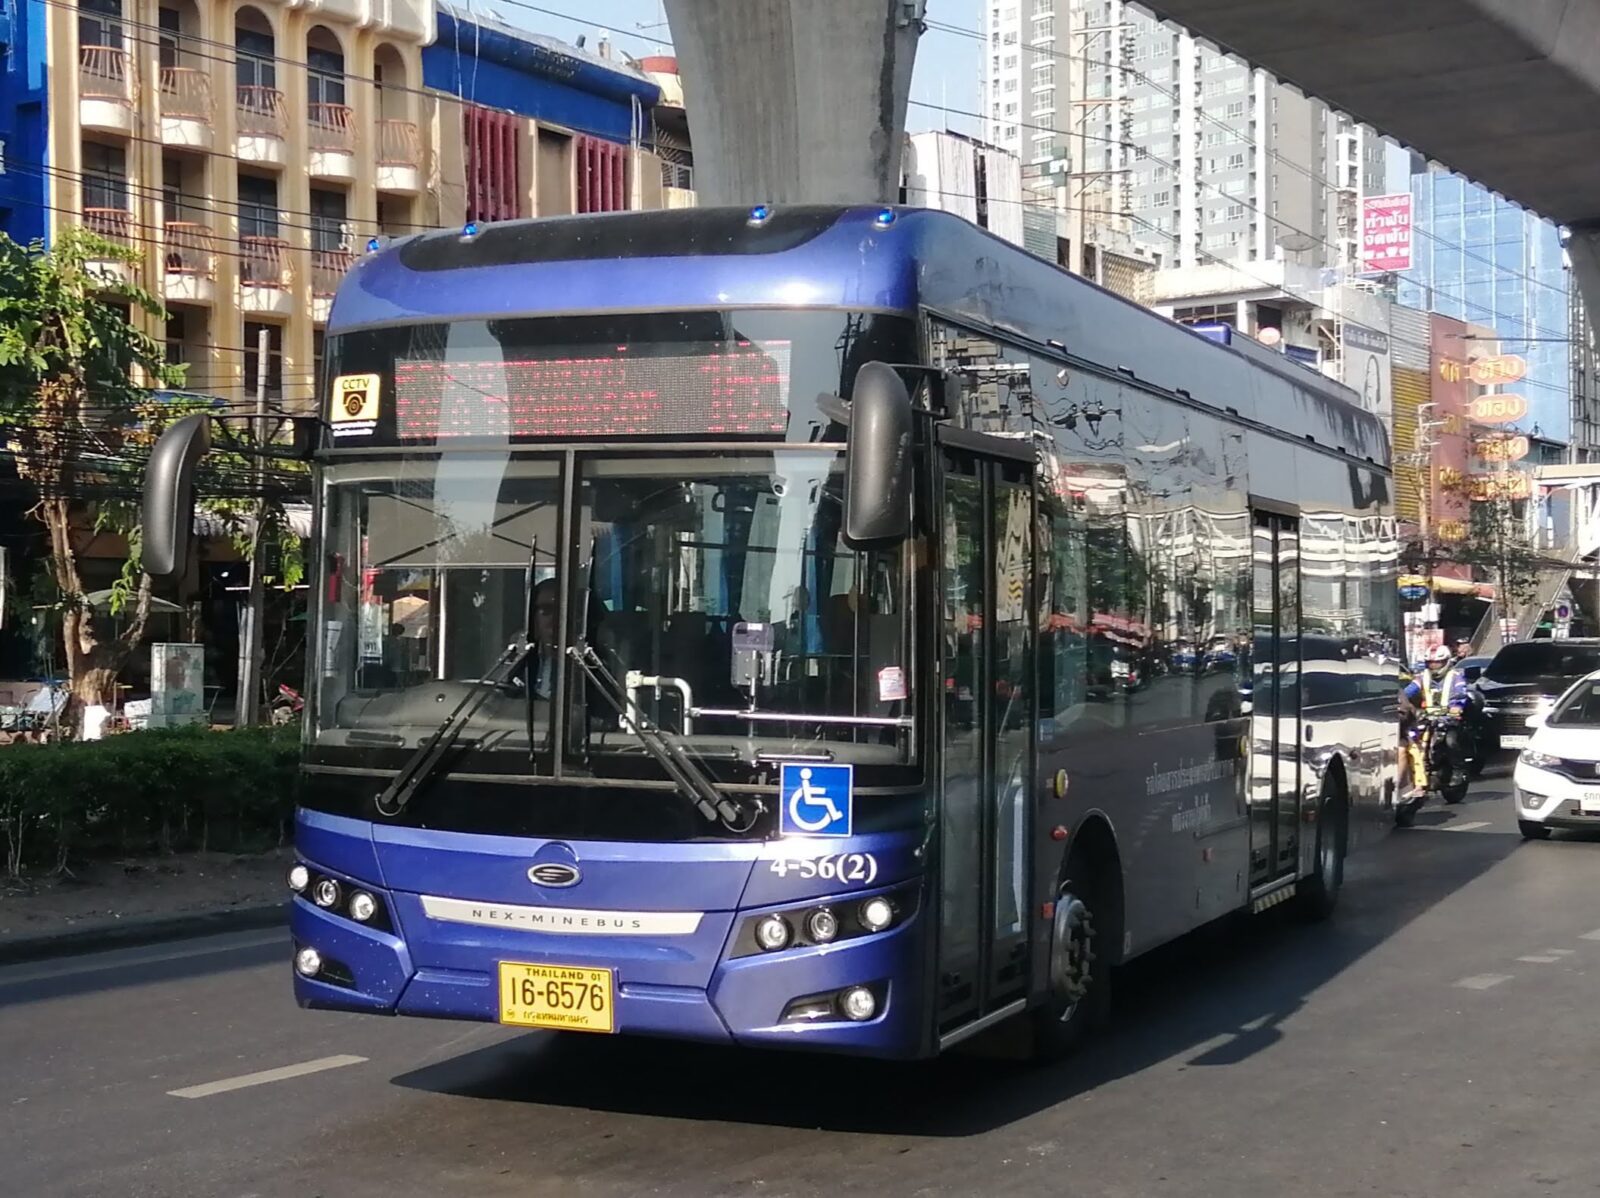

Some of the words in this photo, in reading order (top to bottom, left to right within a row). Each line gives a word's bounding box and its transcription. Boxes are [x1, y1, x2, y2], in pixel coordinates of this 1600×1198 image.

[342, 378, 370, 390] CCTV
[770, 853, 878, 884] 4-56(2)
[472, 909, 642, 928] NEX-MINEBUS
[525, 967, 584, 980] THAILAND
[590, 973, 601, 981] 01
[511, 977, 604, 1011] 16-6576
